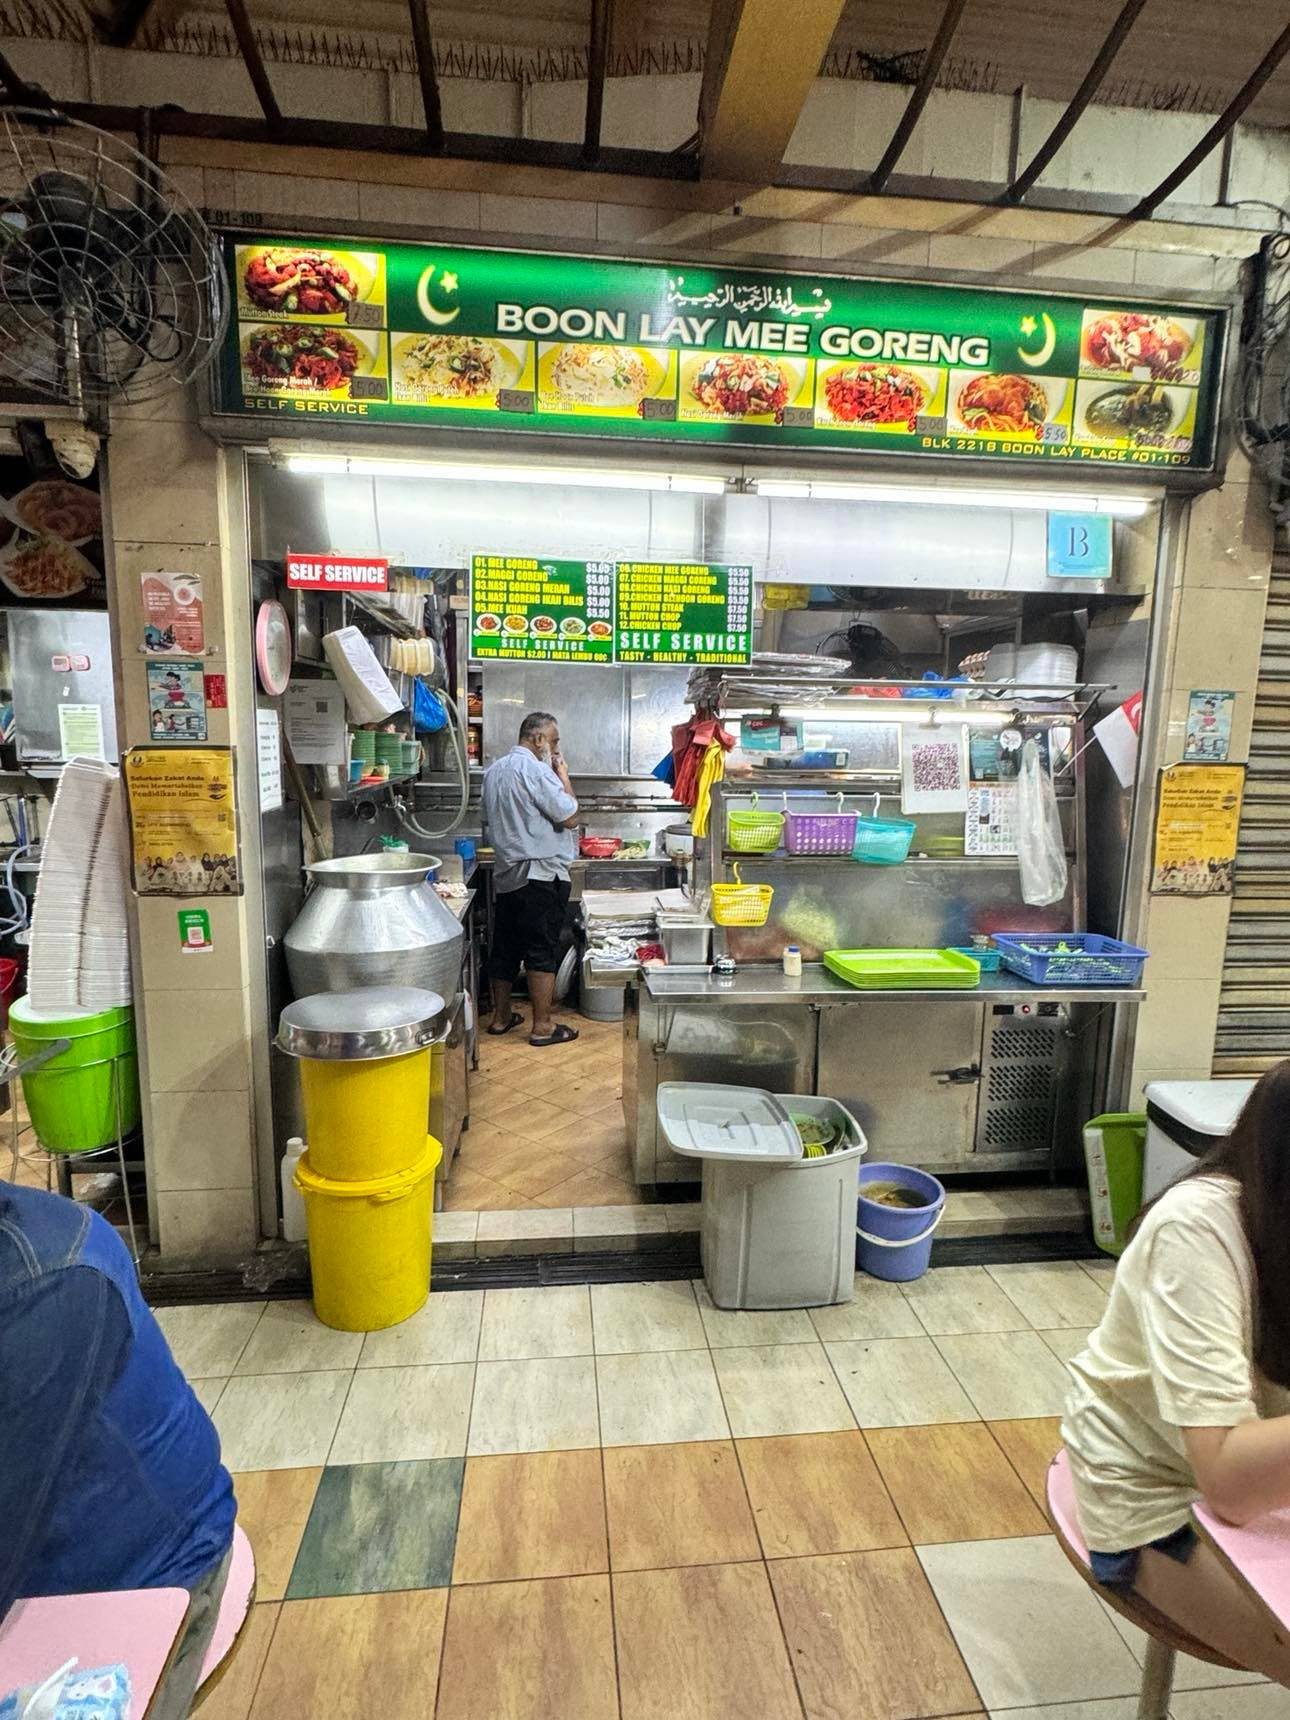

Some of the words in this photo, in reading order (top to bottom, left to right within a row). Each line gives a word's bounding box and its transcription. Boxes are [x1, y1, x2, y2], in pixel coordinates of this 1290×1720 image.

[496, 303, 626, 340] BOON
[639, 313, 717, 345] LAY
[724, 319, 810, 353] MEE
[820, 326, 990, 366] GORENG
[243, 399, 288, 410] SELF
[295, 401, 369, 415] SERVICE
[922, 437, 951, 449] BLK
[1002, 442, 1045, 455] BOON
[1051, 445, 1077, 457] LAY
[1080, 447, 1127, 461] PLACE
[1131, 450, 1191, 464] #01-109
[1068, 527, 1089, 557] B
[488, 557, 505, 569] MEE
[506, 559, 538, 570] GORENG
[289, 562, 323, 582] SELF
[324, 564, 386, 584] SERVICE
[516, 571, 549, 582] GORENG
[508, 582, 541, 593] GORENG
[508, 593, 541, 604] GORENG
[630, 602, 661, 612] MUTTON
[501, 638, 528, 649] SELF
[534, 639, 585, 651] SERVICE
[619, 631, 661, 650] SELF
[670, 632, 747, 652] SERVICE
[619, 651, 645, 661] TASTY
[652, 652, 688, 662] HEALTHY
[695, 653, 747, 664] TRADITIONAL
